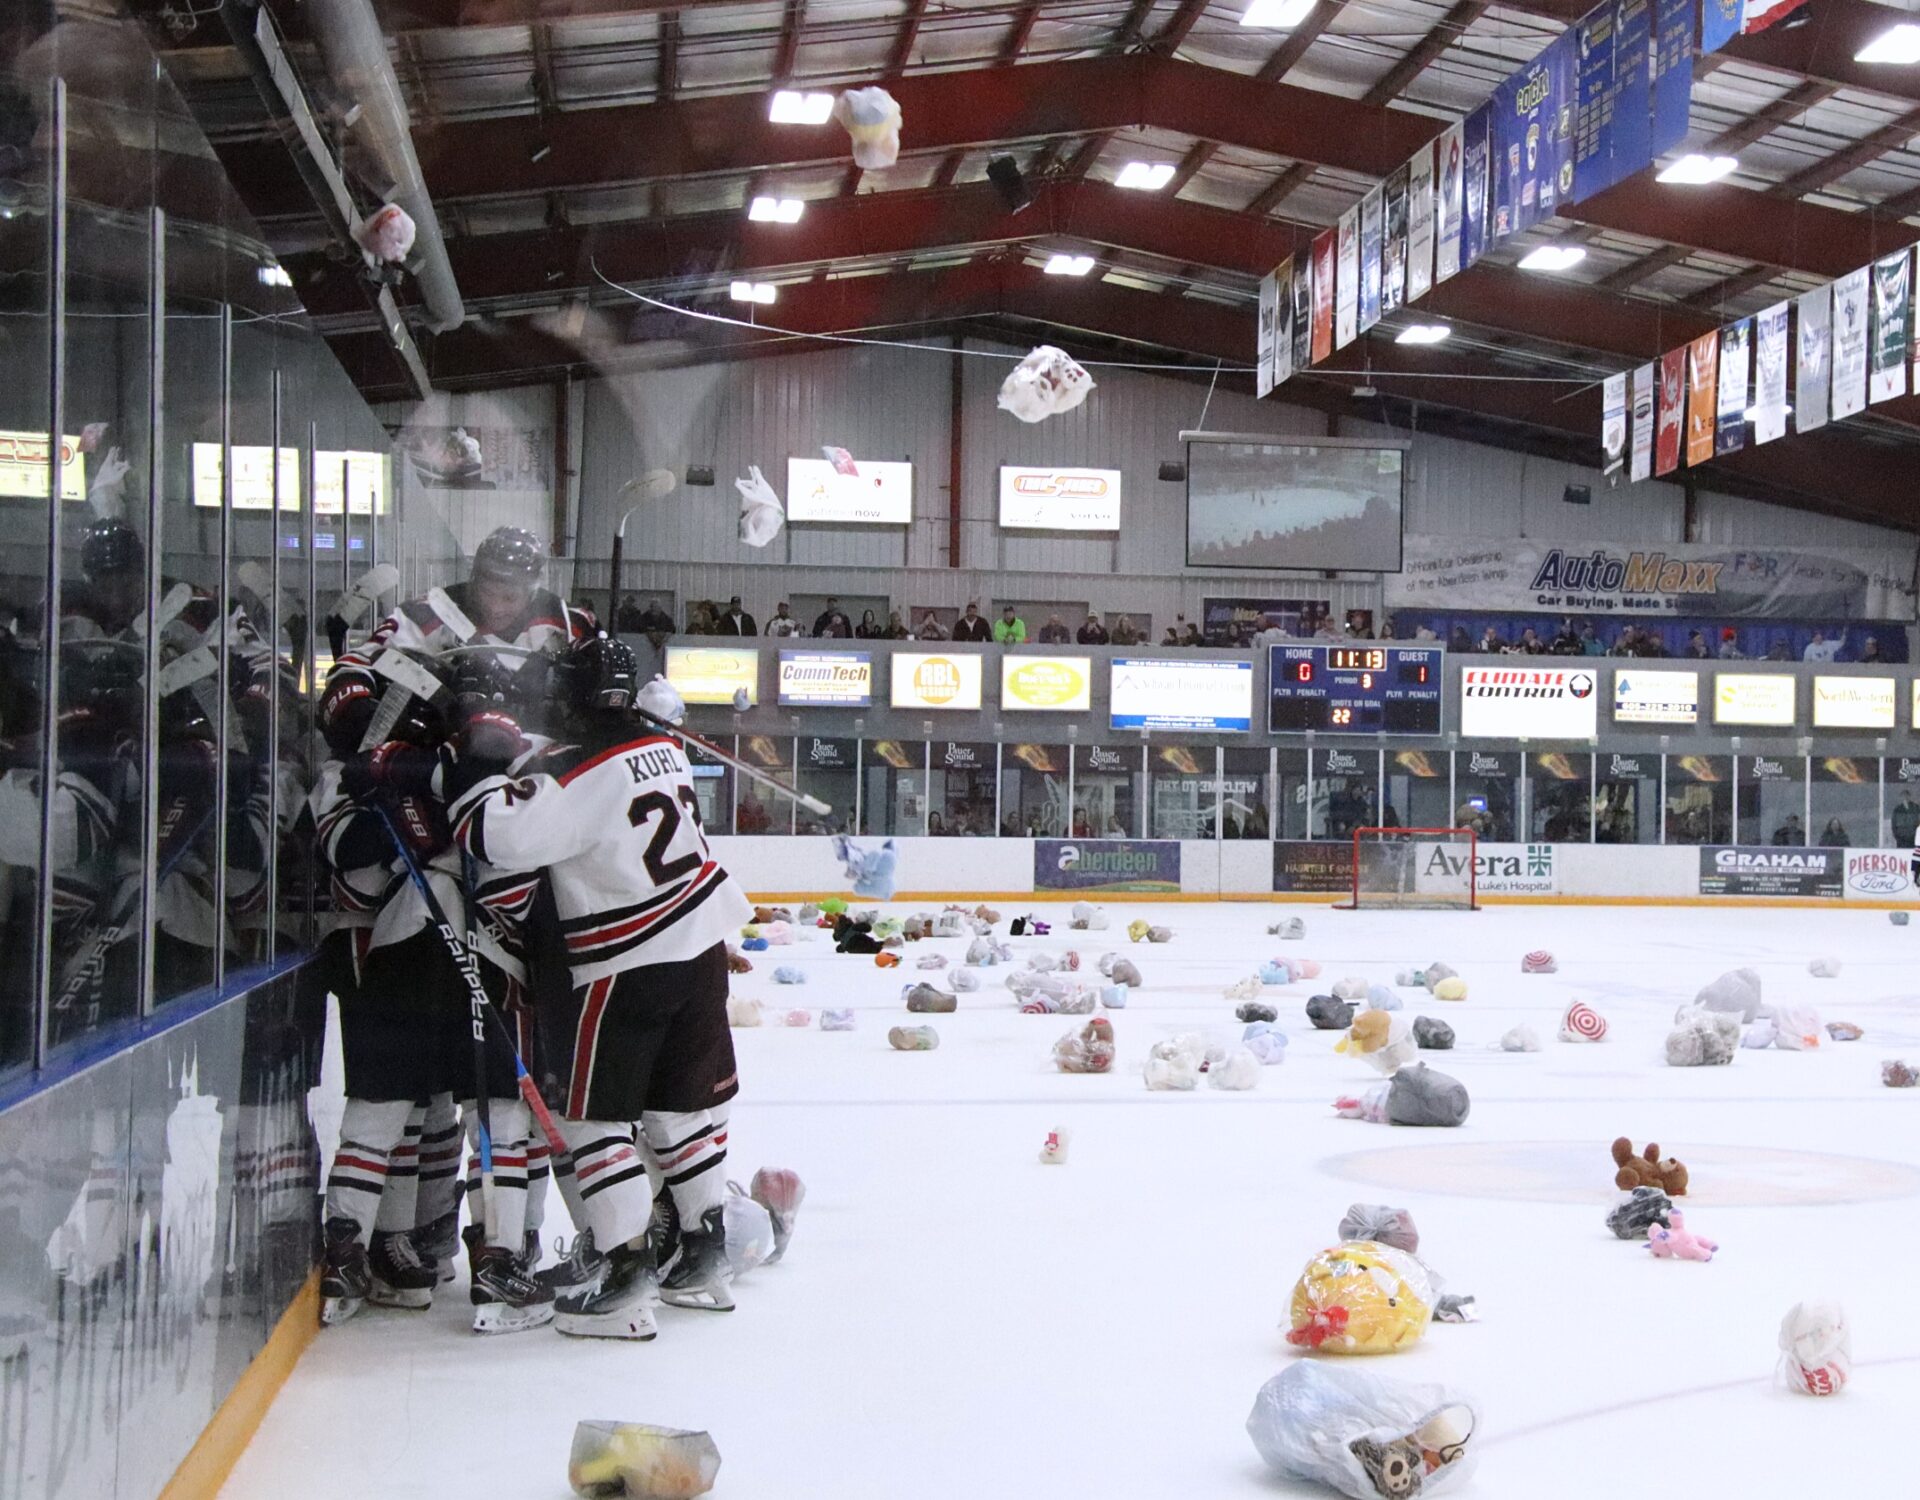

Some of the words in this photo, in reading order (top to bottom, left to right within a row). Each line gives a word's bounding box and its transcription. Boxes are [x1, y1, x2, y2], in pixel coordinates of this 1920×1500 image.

[1530, 549, 1723, 595] AutoMaxx
[1537, 594, 1562, 606] Car
[1622, 597, 1661, 609] Made
[1285, 649, 1313, 659] HOME
[1336, 650, 1383, 669] 11:13
[1398, 652, 1429, 662] GUEST
[783, 664, 868, 681] CommTech
[921, 663, 957, 686] RBL
[1298, 663, 1311, 681] 0
[1466, 671, 1565, 686] CLIMATE
[1361, 674, 1373, 689] 3
[1296, 688, 1327, 697] PENALTY
[1408, 690, 1438, 699] PENALTY
[1466, 686, 1564, 698] CONTROL
[1332, 708, 1351, 724] 22
[810, 747, 838, 761] Sound
[945, 751, 975, 765] Sound
[1089, 754, 1120, 768] Sound
[625, 747, 683, 784] KUHL
[1326, 758, 1357, 771] Sound
[1469, 761, 1499, 773] Sound
[1898, 767, 1920, 779] Sou
[1424, 844, 1522, 878] Avera
[1715, 849, 1827, 868] GRAHAM
[1849, 853, 1908, 876] PIERSON
[1477, 881, 1507, 891] Luke's
[1510, 881, 1552, 893] Hospital
[1860, 873, 1897, 890] Ford
